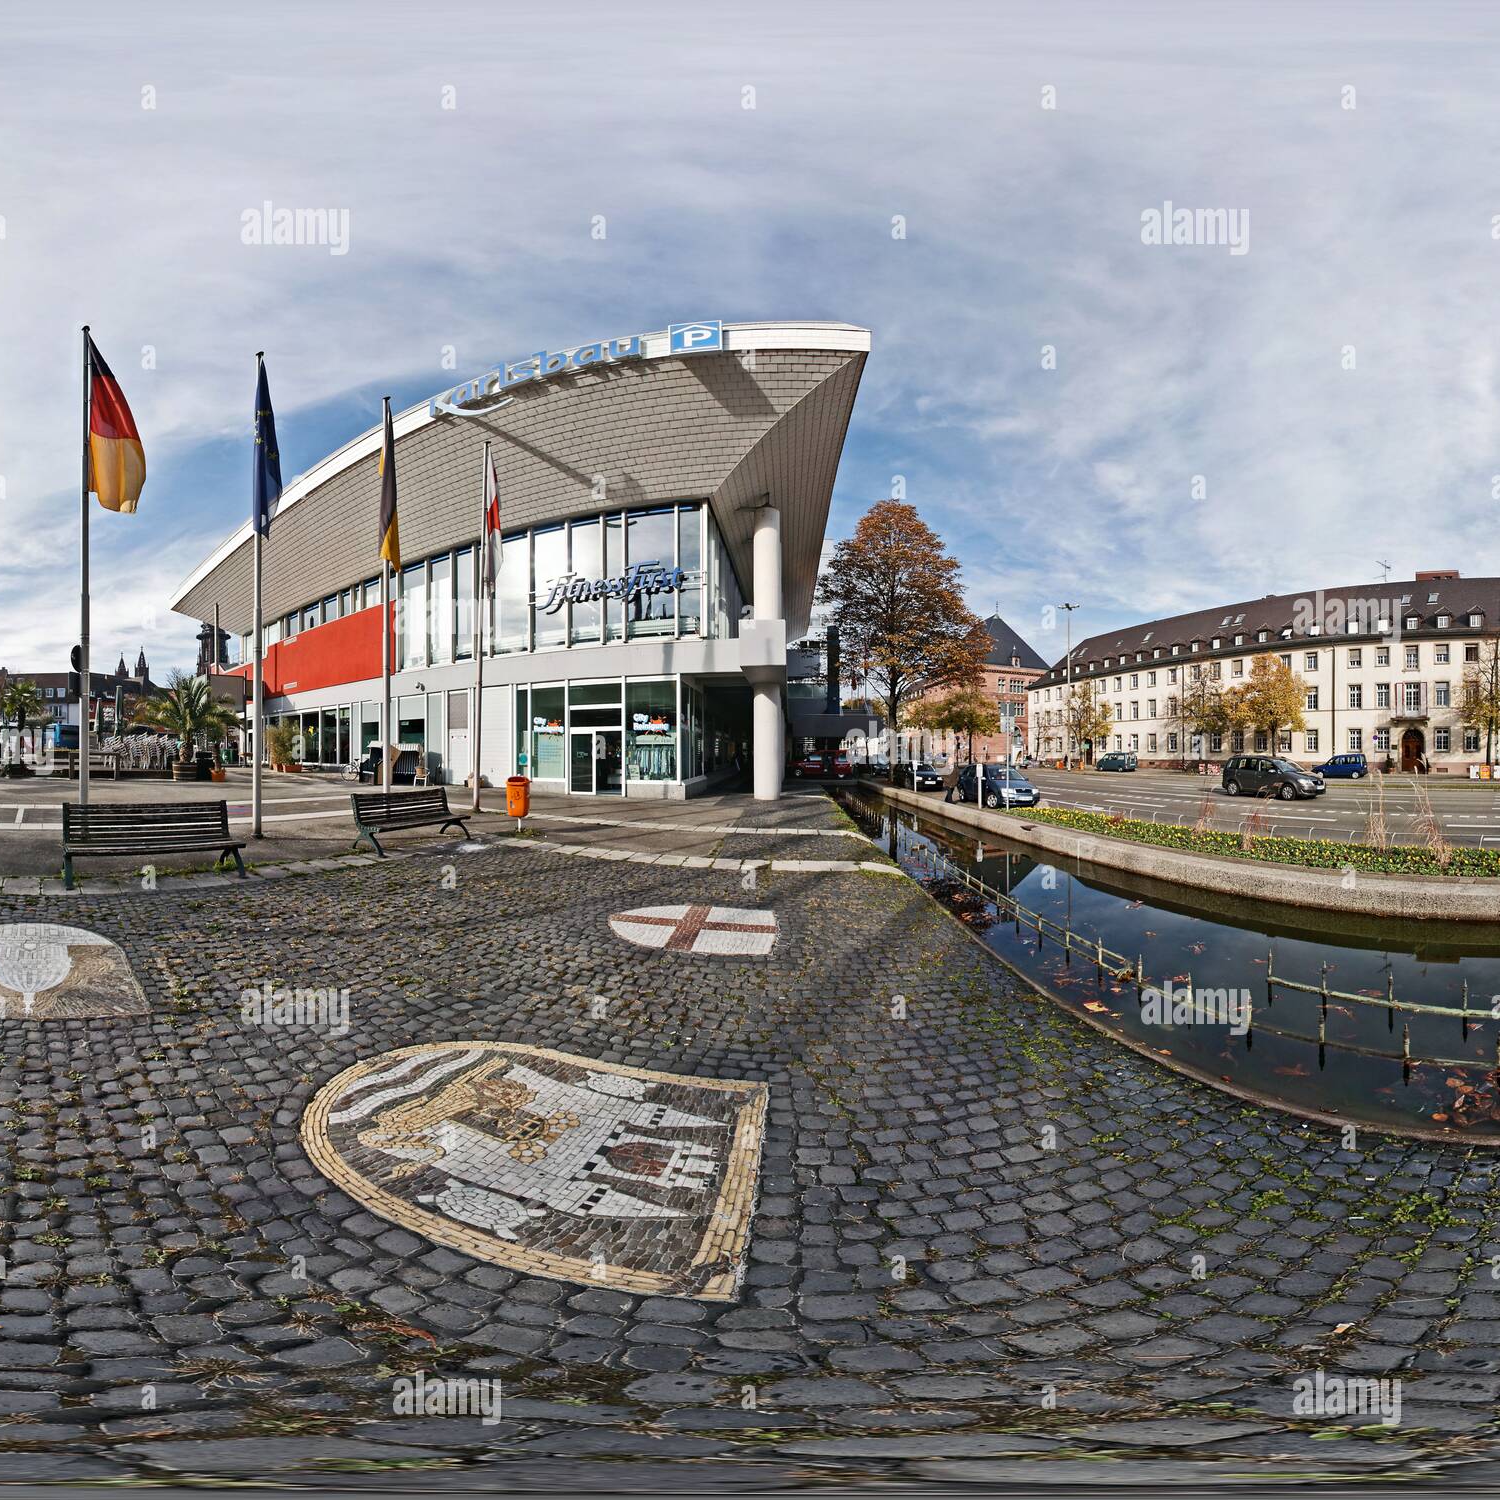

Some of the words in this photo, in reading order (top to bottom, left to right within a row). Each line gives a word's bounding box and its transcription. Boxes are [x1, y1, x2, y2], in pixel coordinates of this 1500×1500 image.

[683, 329, 712, 348] P
[429, 336, 641, 417] Karlsbau
[533, 715, 547, 726] City
[633, 713, 649, 723] City
[633, 722, 670, 731] Reinigung
